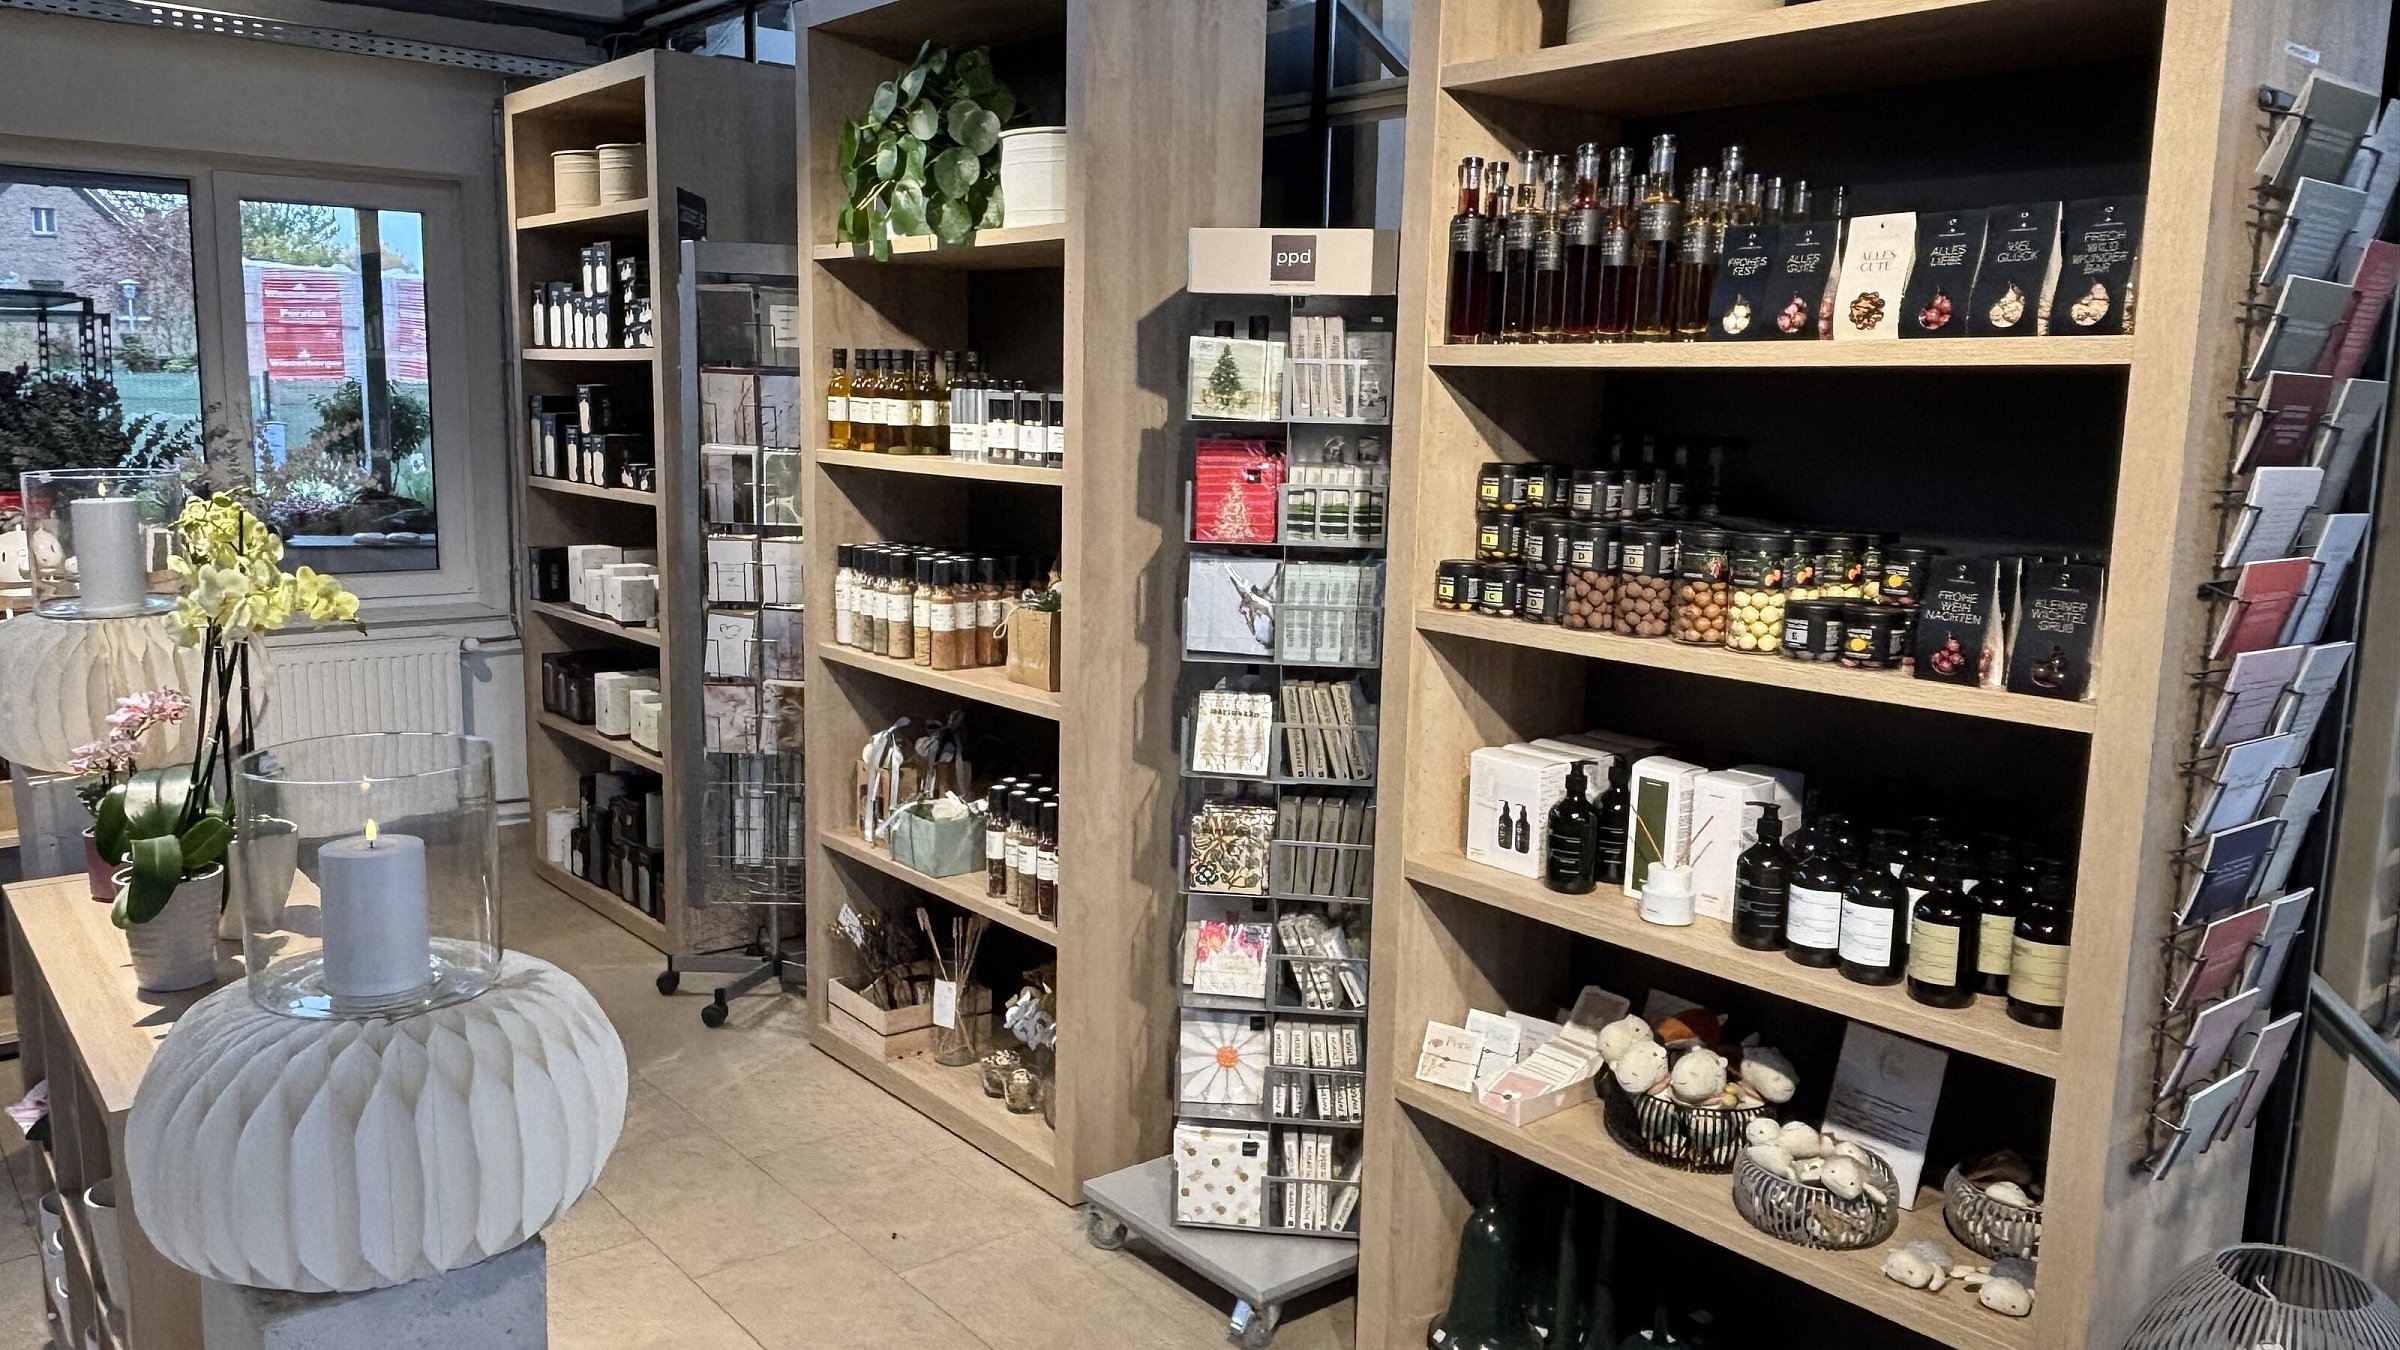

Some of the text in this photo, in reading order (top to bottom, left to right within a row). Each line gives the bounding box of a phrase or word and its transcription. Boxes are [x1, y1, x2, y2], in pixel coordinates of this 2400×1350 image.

[1862, 250, 1896, 260] ALLES
[1930, 244, 1967, 255] ALLES
[1277, 249, 1311, 266] ppd
[1787, 253, 1821, 263] ALLES
[1732, 267, 1756, 276] FEST
[1787, 262, 1815, 273] GUTE
[1938, 590, 1979, 603] FROHE
[1941, 601, 1971, 612] WEIH
[1925, 609, 1982, 624] NACHTEN
[2031, 609, 2087, 624] WICHTEL
